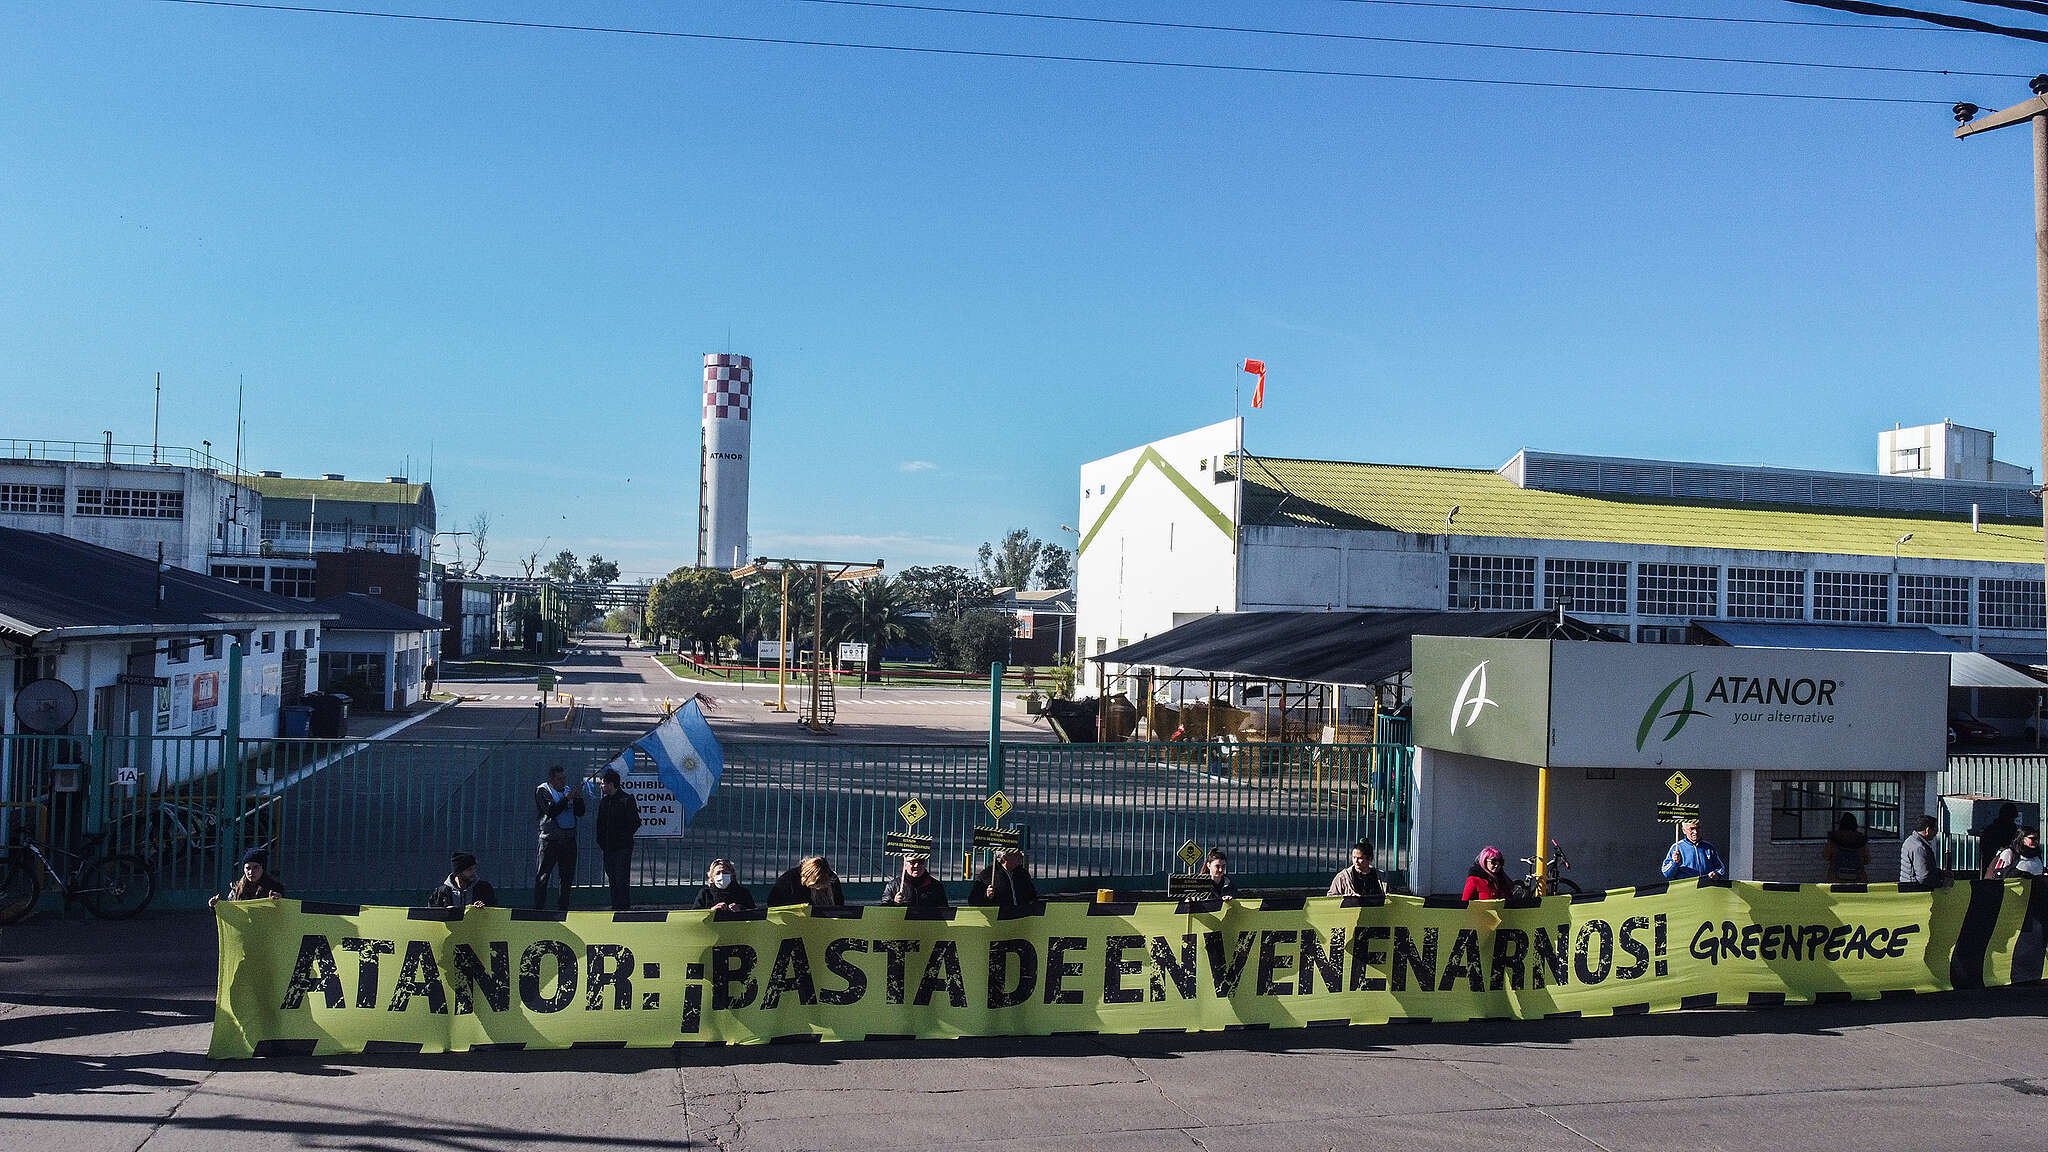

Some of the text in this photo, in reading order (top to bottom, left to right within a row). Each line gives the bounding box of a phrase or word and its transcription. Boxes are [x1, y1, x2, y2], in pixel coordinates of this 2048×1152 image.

[1733, 710, 1835, 724] your alternative
[119, 771, 136, 782] 1A
[620, 780, 665, 789] ROHIBID
[660, 805, 674, 813] AL
[640, 817, 666, 826] TON
[1689, 920, 1921, 966] GREENPEACE
[280, 912, 1669, 1034] ATANOR: ¡BASTA DE ENVENENARNOS!
